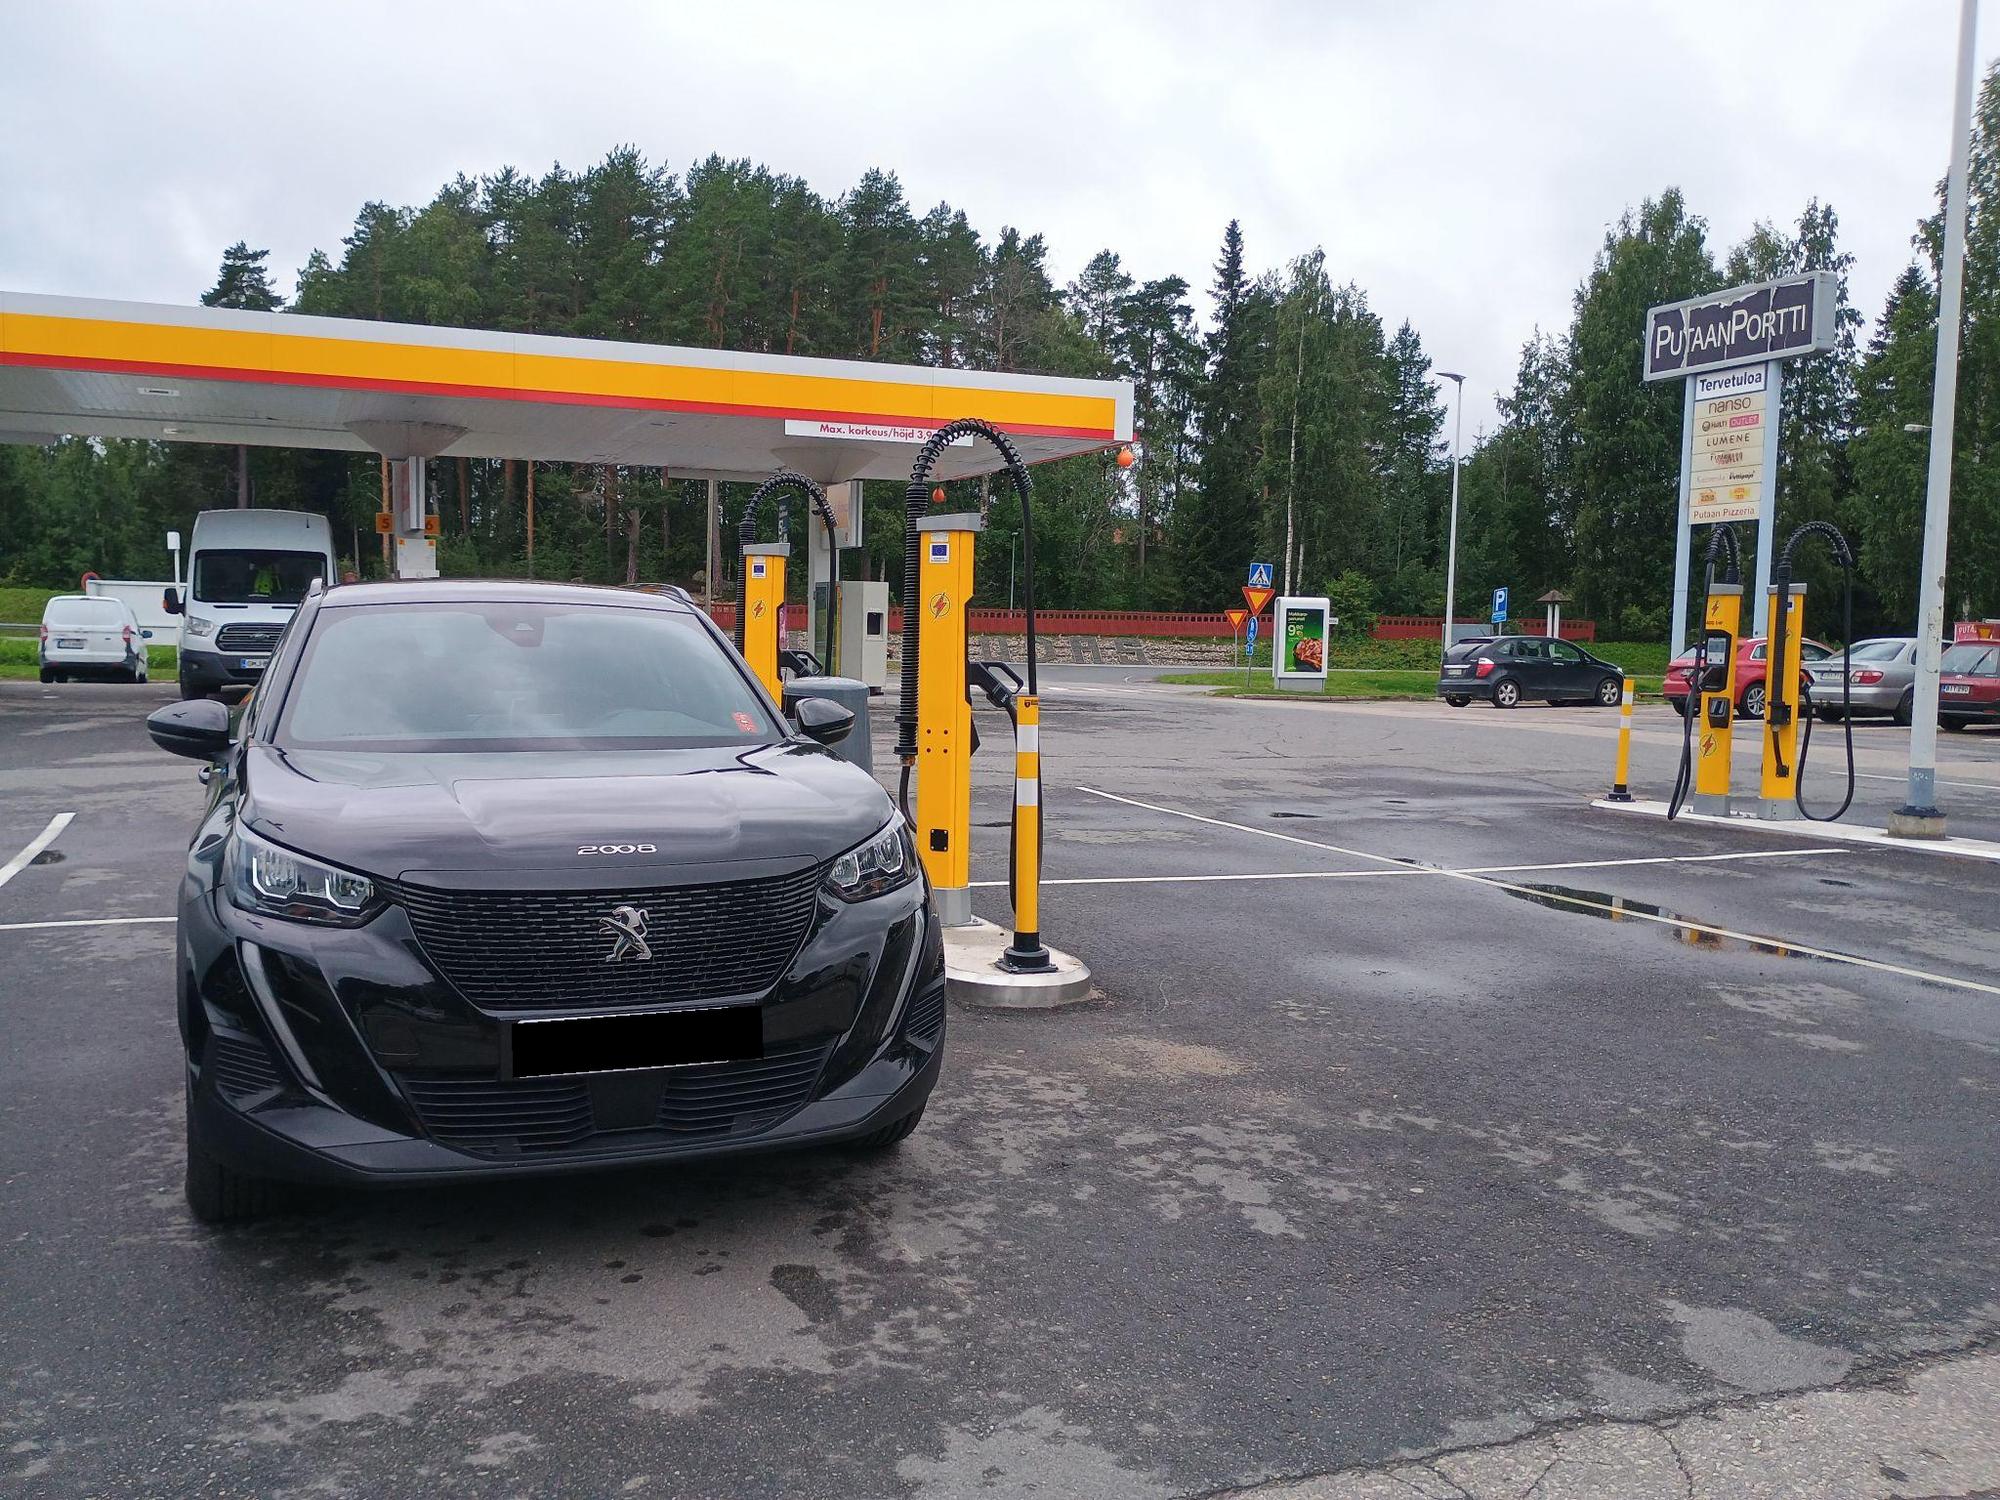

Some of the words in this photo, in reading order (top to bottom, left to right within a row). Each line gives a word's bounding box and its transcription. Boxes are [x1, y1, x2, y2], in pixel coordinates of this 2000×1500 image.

[1700, 371, 1762, 392] Tervetuloa
[1709, 397, 1751, 414] nanso
[1732, 416, 1758, 426] OUTLET
[819, 423, 846, 434] Max.
[848, 425, 914, 440] korkeus/höjd
[1706, 433, 1750, 447] LUMENE
[1693, 510, 1721, 520] Putaan
[1723, 508, 1755, 517] Pizzeria
[1496, 591, 1505, 611] P
[577, 844, 658, 855] 2008
